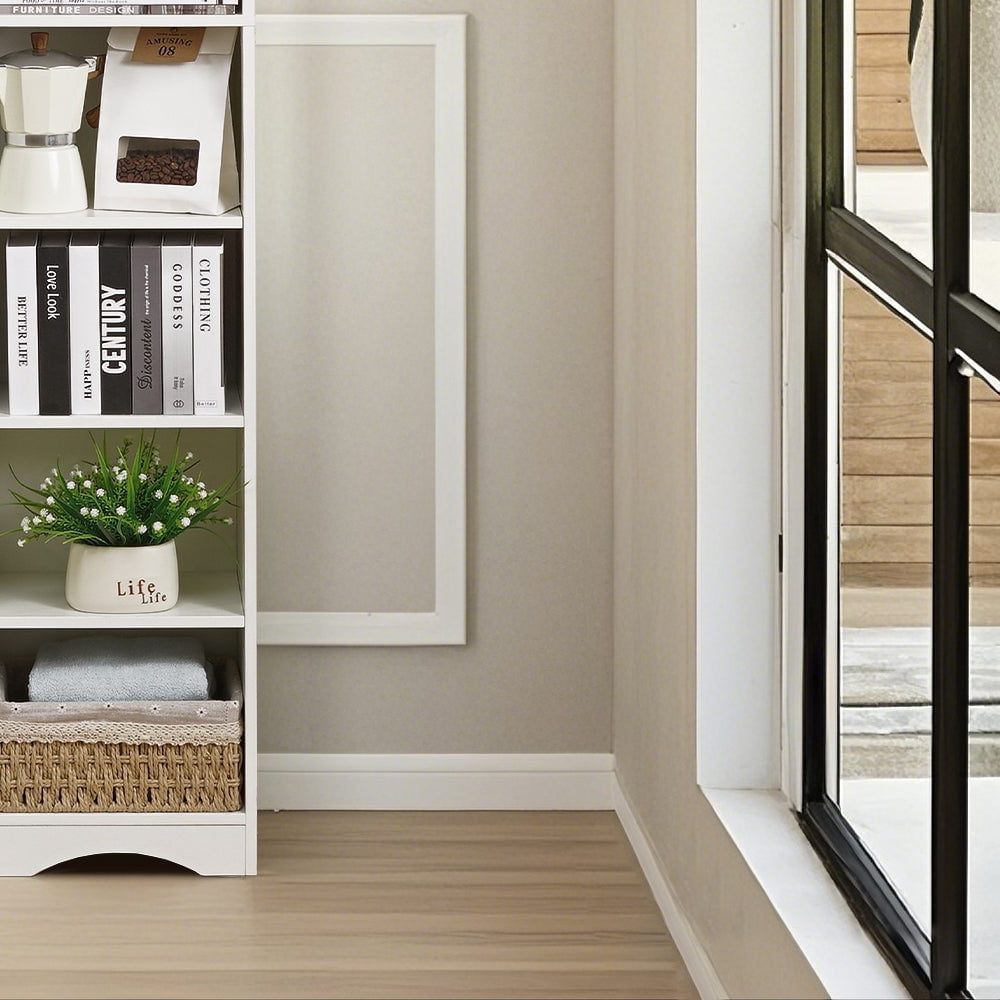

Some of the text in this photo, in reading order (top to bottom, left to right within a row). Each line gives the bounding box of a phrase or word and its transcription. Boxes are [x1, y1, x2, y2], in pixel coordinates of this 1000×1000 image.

[12, 6, 135, 14] FURNITURE DESIGN
[146, 37, 193, 47] AMUSING
[158, 46, 176, 57] 08
[46, 265, 61, 320] Love Look
[172, 263, 183, 329] GODDESS
[199, 258, 211, 332] CLOTHING
[17, 296, 28, 367] BETTER LIFE
[101, 284, 127, 375] CENTURY
[137, 318, 152, 390] Discontent
[117, 579, 156, 597] Life
[141, 592, 167, 604] Life
